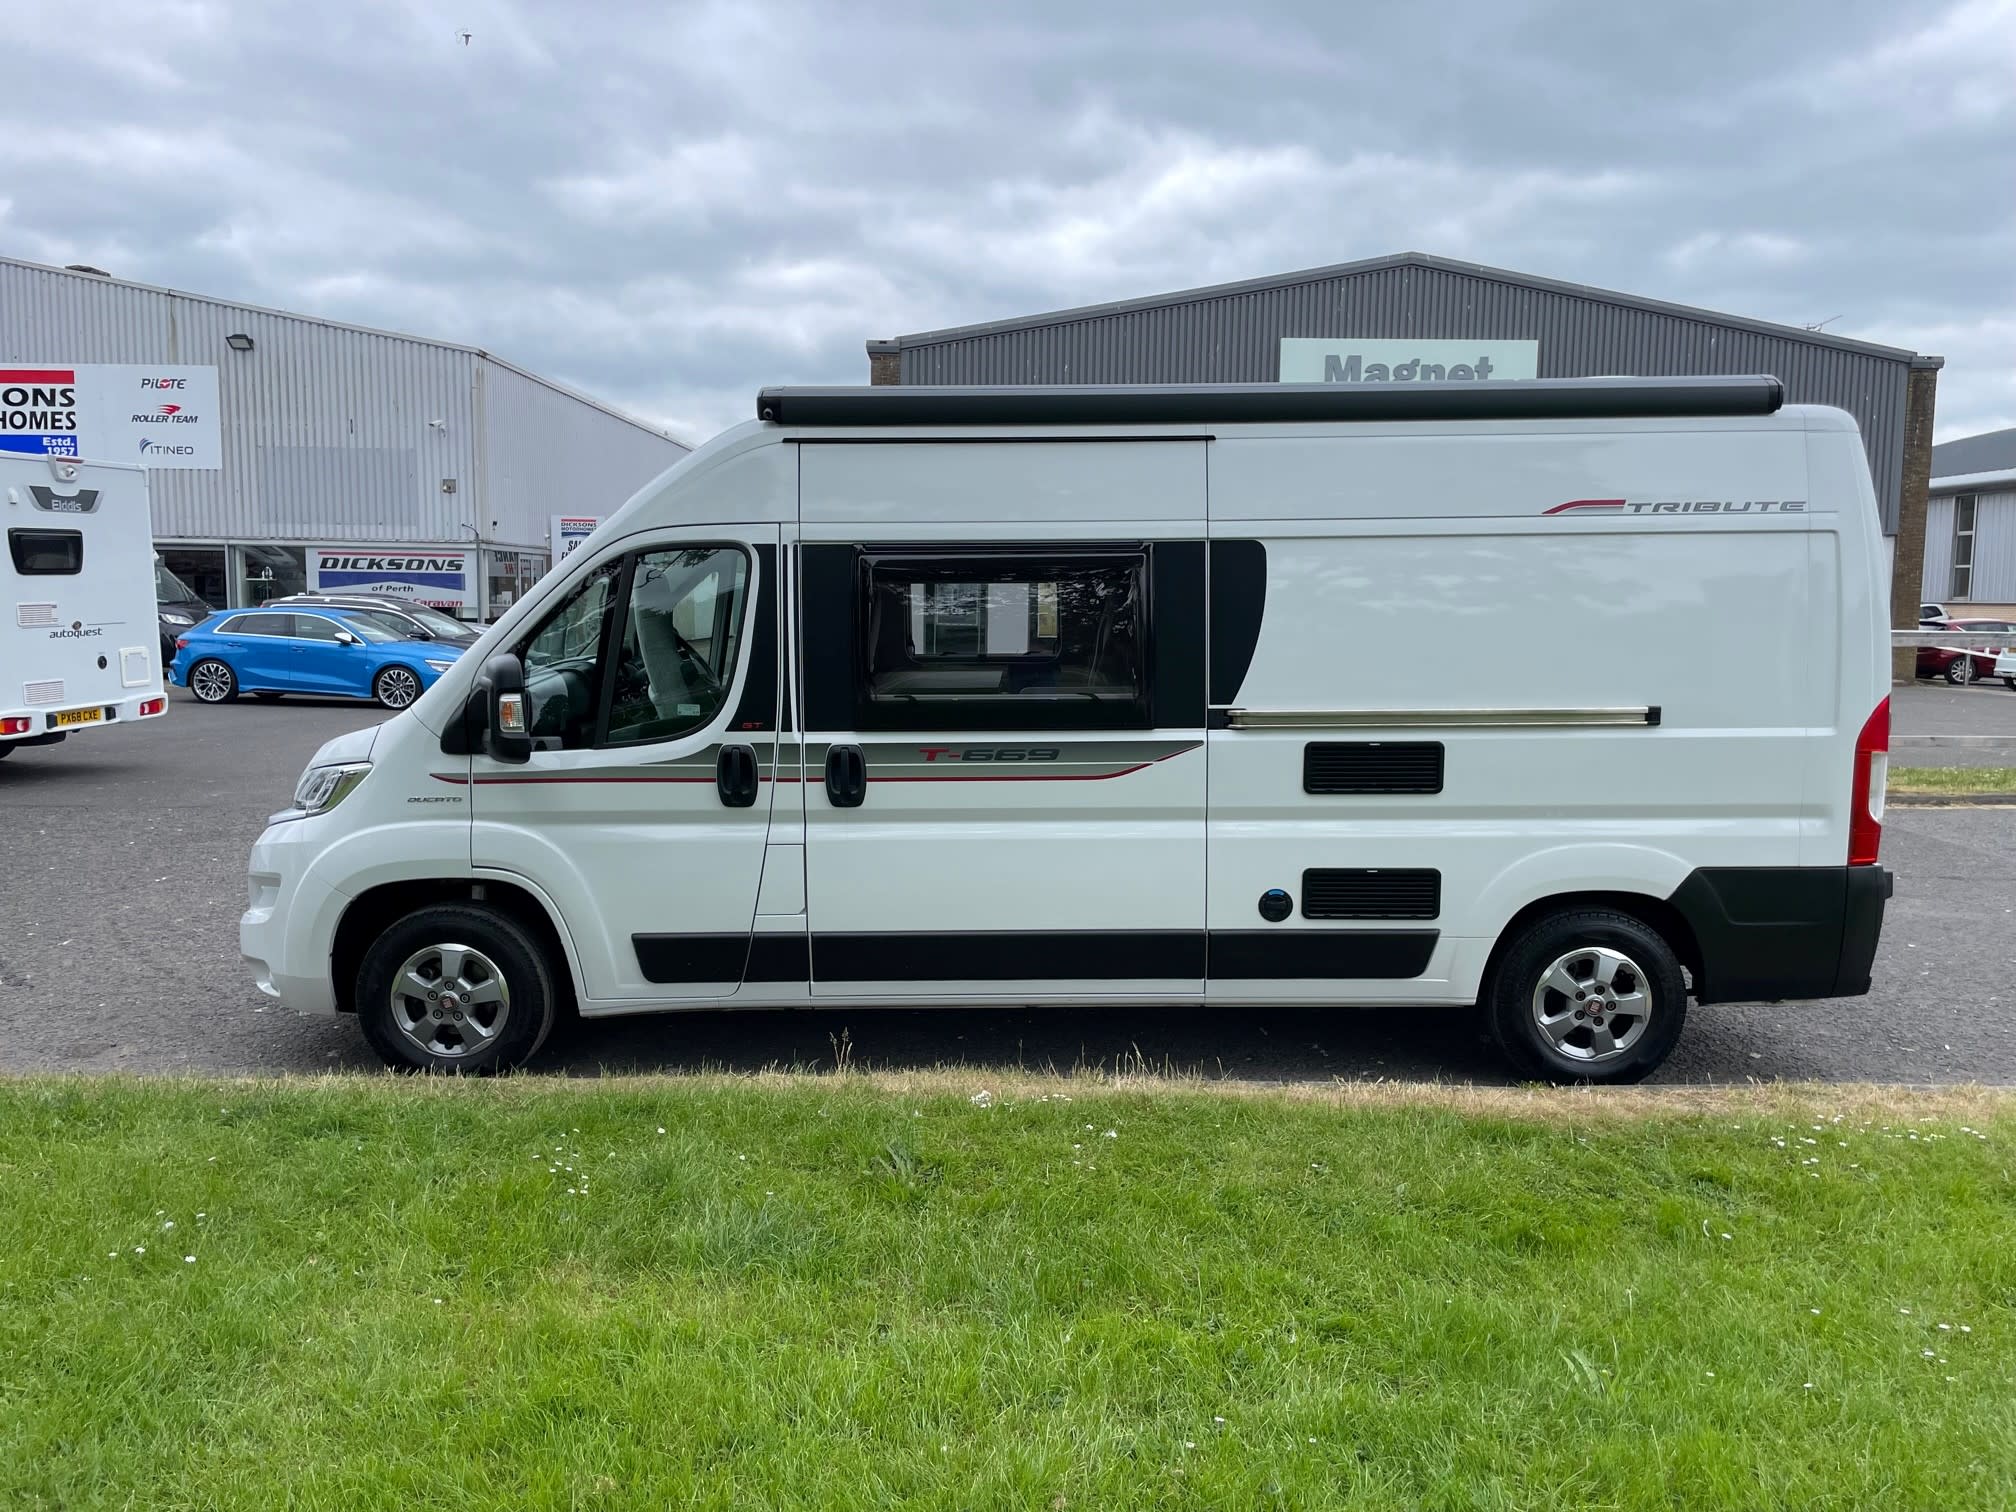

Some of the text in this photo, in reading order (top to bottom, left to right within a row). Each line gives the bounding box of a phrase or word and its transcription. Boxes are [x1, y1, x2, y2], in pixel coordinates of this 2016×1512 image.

[1324, 354, 1493, 382] Magnet
[131, 414, 198, 423] ROLLER TEAM
[42, 436, 75, 446] Estd.
[47, 446, 75, 456] 1957
[150, 445, 194, 455] ITINEO
[1627, 501, 1807, 513] TRIBUTE
[319, 557, 465, 571] DICKSONS
[49, 627, 103, 639] autoquest
[60, 709, 98, 724] PX68 CXE
[918, 748, 1061, 761] T-669
